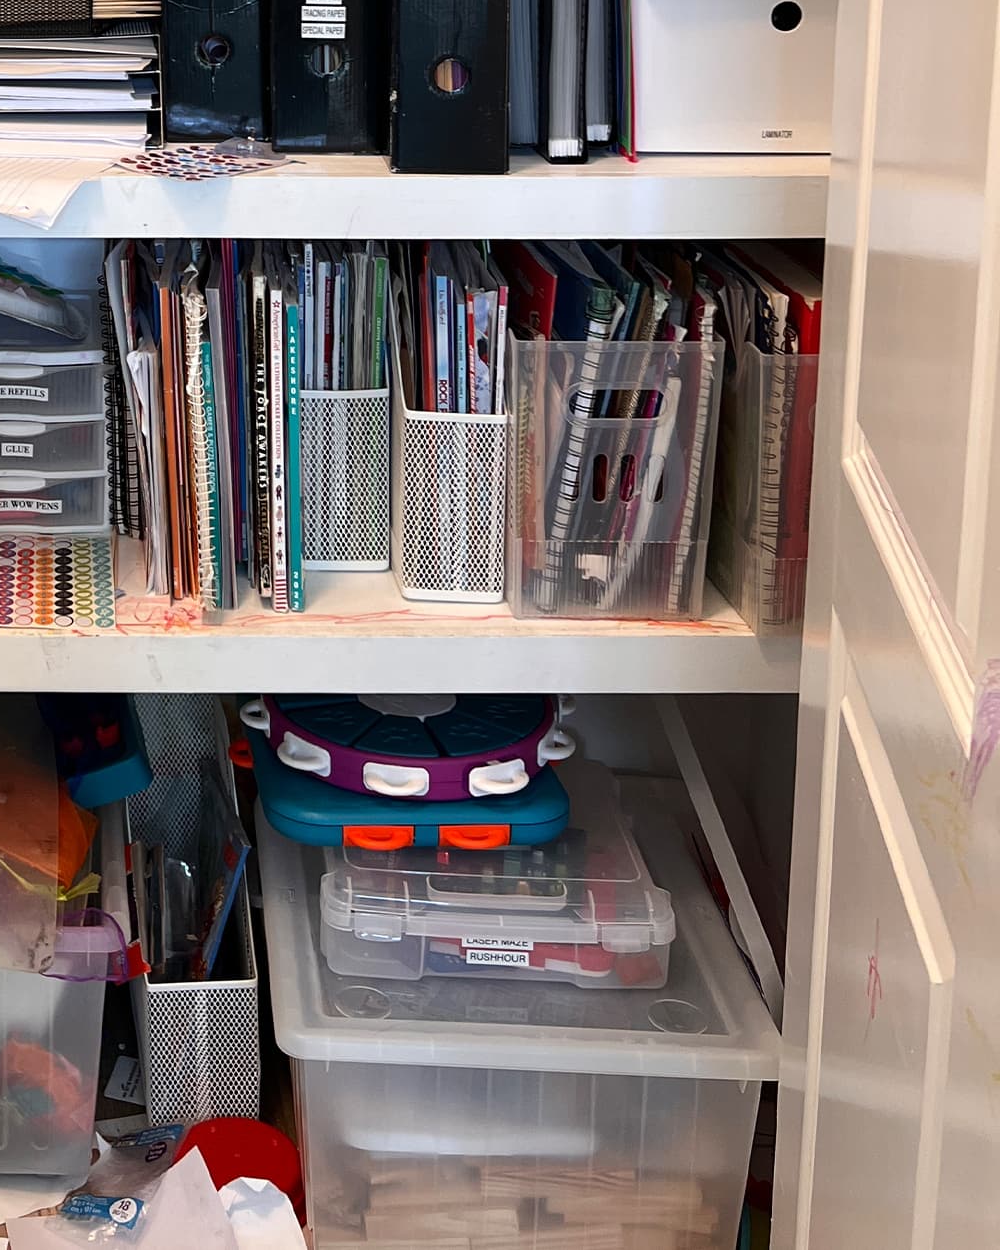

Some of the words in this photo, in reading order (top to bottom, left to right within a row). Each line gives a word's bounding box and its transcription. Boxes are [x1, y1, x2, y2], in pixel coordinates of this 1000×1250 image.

[327, 9, 345, 18] PAPER
[302, 26, 325, 35] SPECIAL
[326, 26, 343, 35] PAPER
[256, 362, 265, 383] THE
[8, 388, 46, 398] REFILLS
[438, 379, 448, 405] ROCK
[5, 445, 30, 454] GLUE
[257, 433, 268, 489] AWAKENS
[11, 500, 34, 509] WOW
[36, 501, 60, 511] PENS
[469, 951, 527, 963] RUSHHOUR
[118, 1200, 132, 1211] 18
